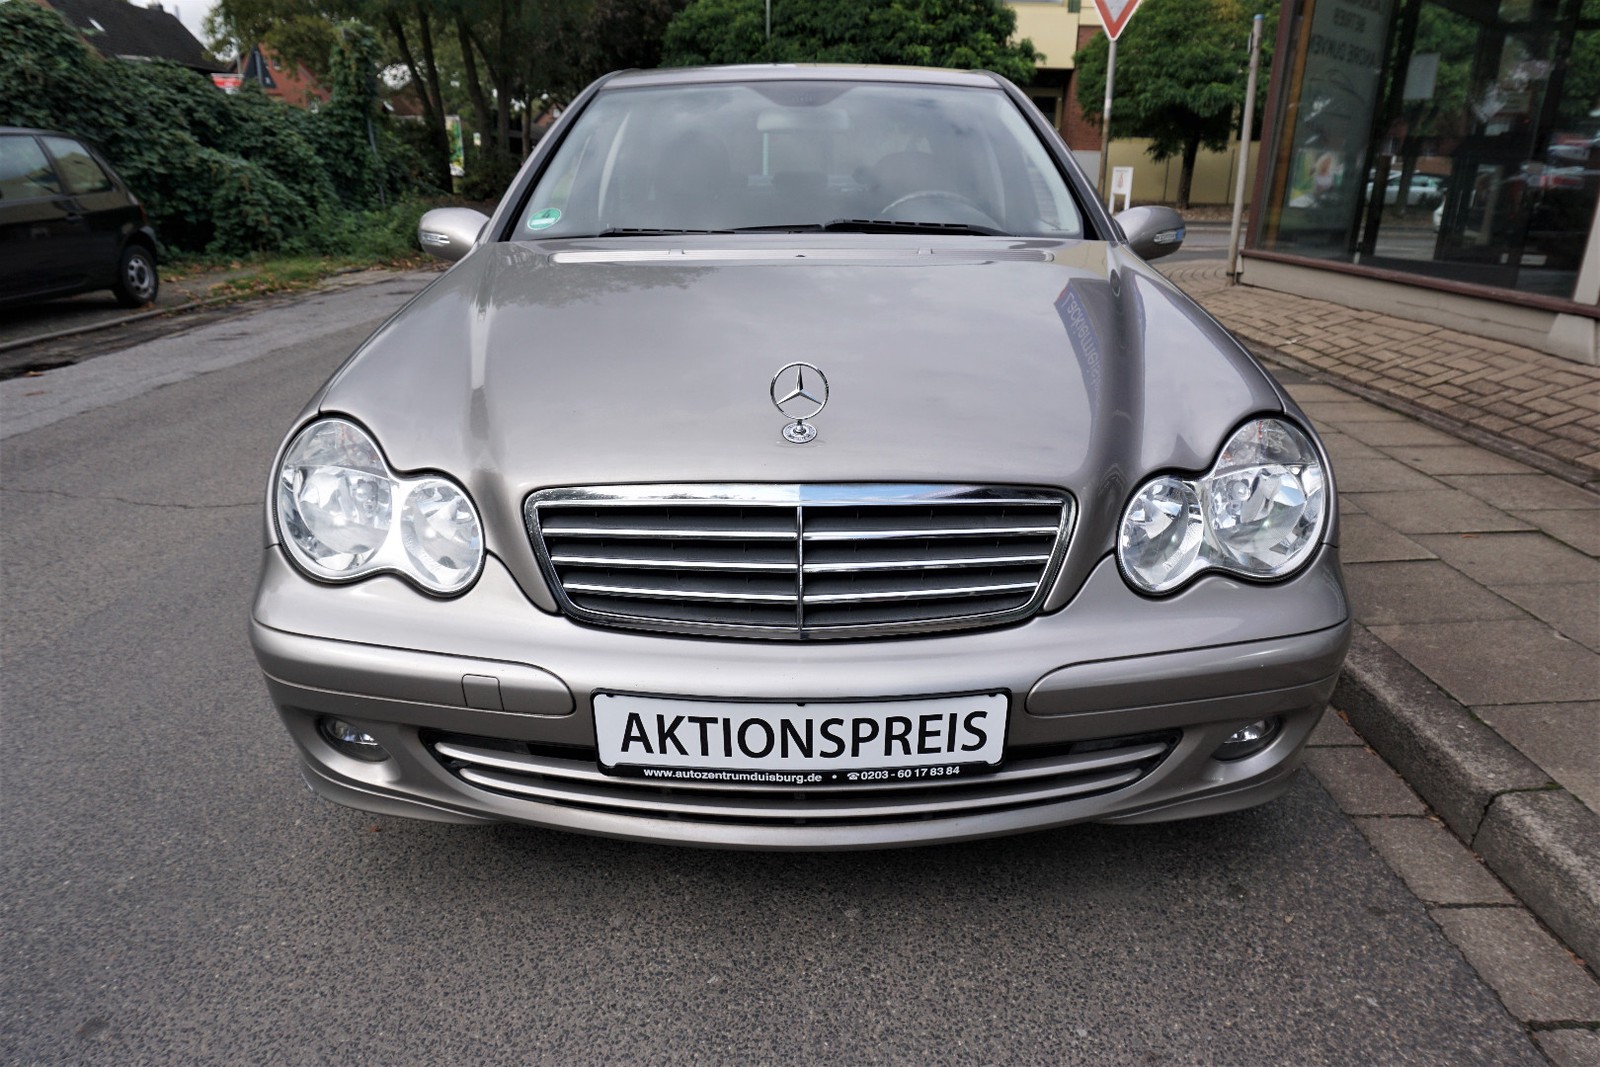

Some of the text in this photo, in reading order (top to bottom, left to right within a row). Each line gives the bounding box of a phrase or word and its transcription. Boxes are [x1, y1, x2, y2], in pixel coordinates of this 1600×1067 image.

[620, 710, 989, 759] AKTIONSPREIS
[643, 768, 822, 784] www.autozentrumduisburg.de
[860, 770, 889, 780] 0203
[897, 769, 912, 778] 60
[914, 768, 928, 777] 17
[929, 767, 944, 776] 83
[945, 766, 960, 775] 84
